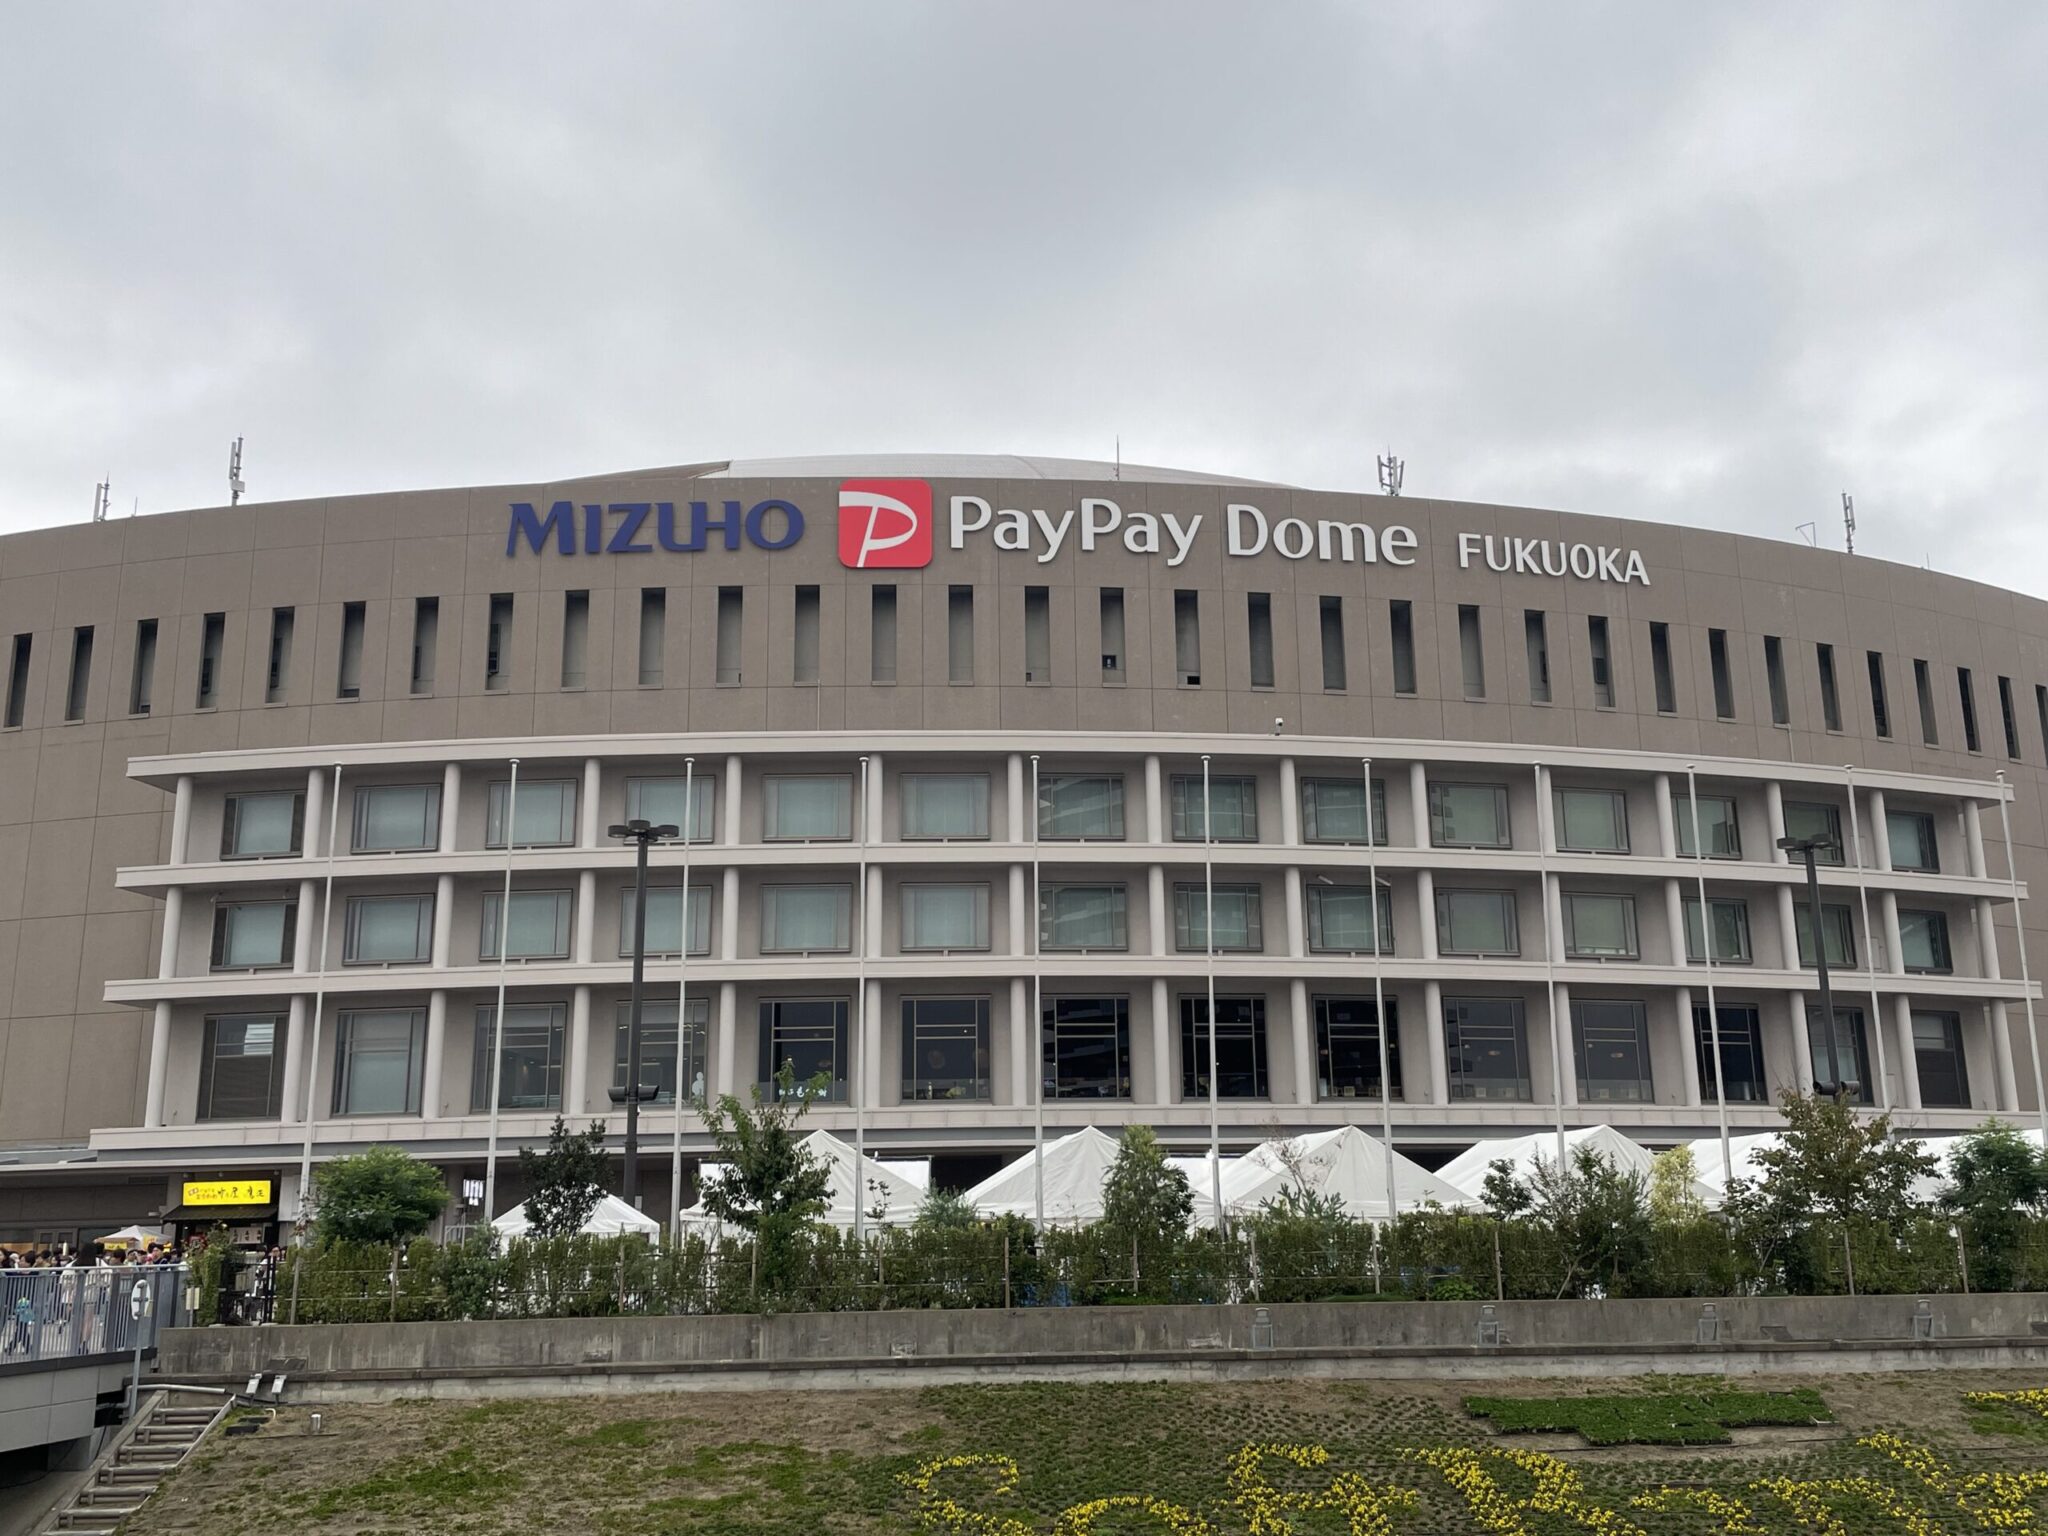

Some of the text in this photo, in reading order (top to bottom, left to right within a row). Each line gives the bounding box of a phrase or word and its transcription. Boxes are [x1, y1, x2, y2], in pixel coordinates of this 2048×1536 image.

[507, 499, 804, 555] MIZUHO
[949, 495, 1203, 566] PayPay
[1226, 503, 1418, 566] Dome
[1457, 532, 1652, 586] FUKUOKA
